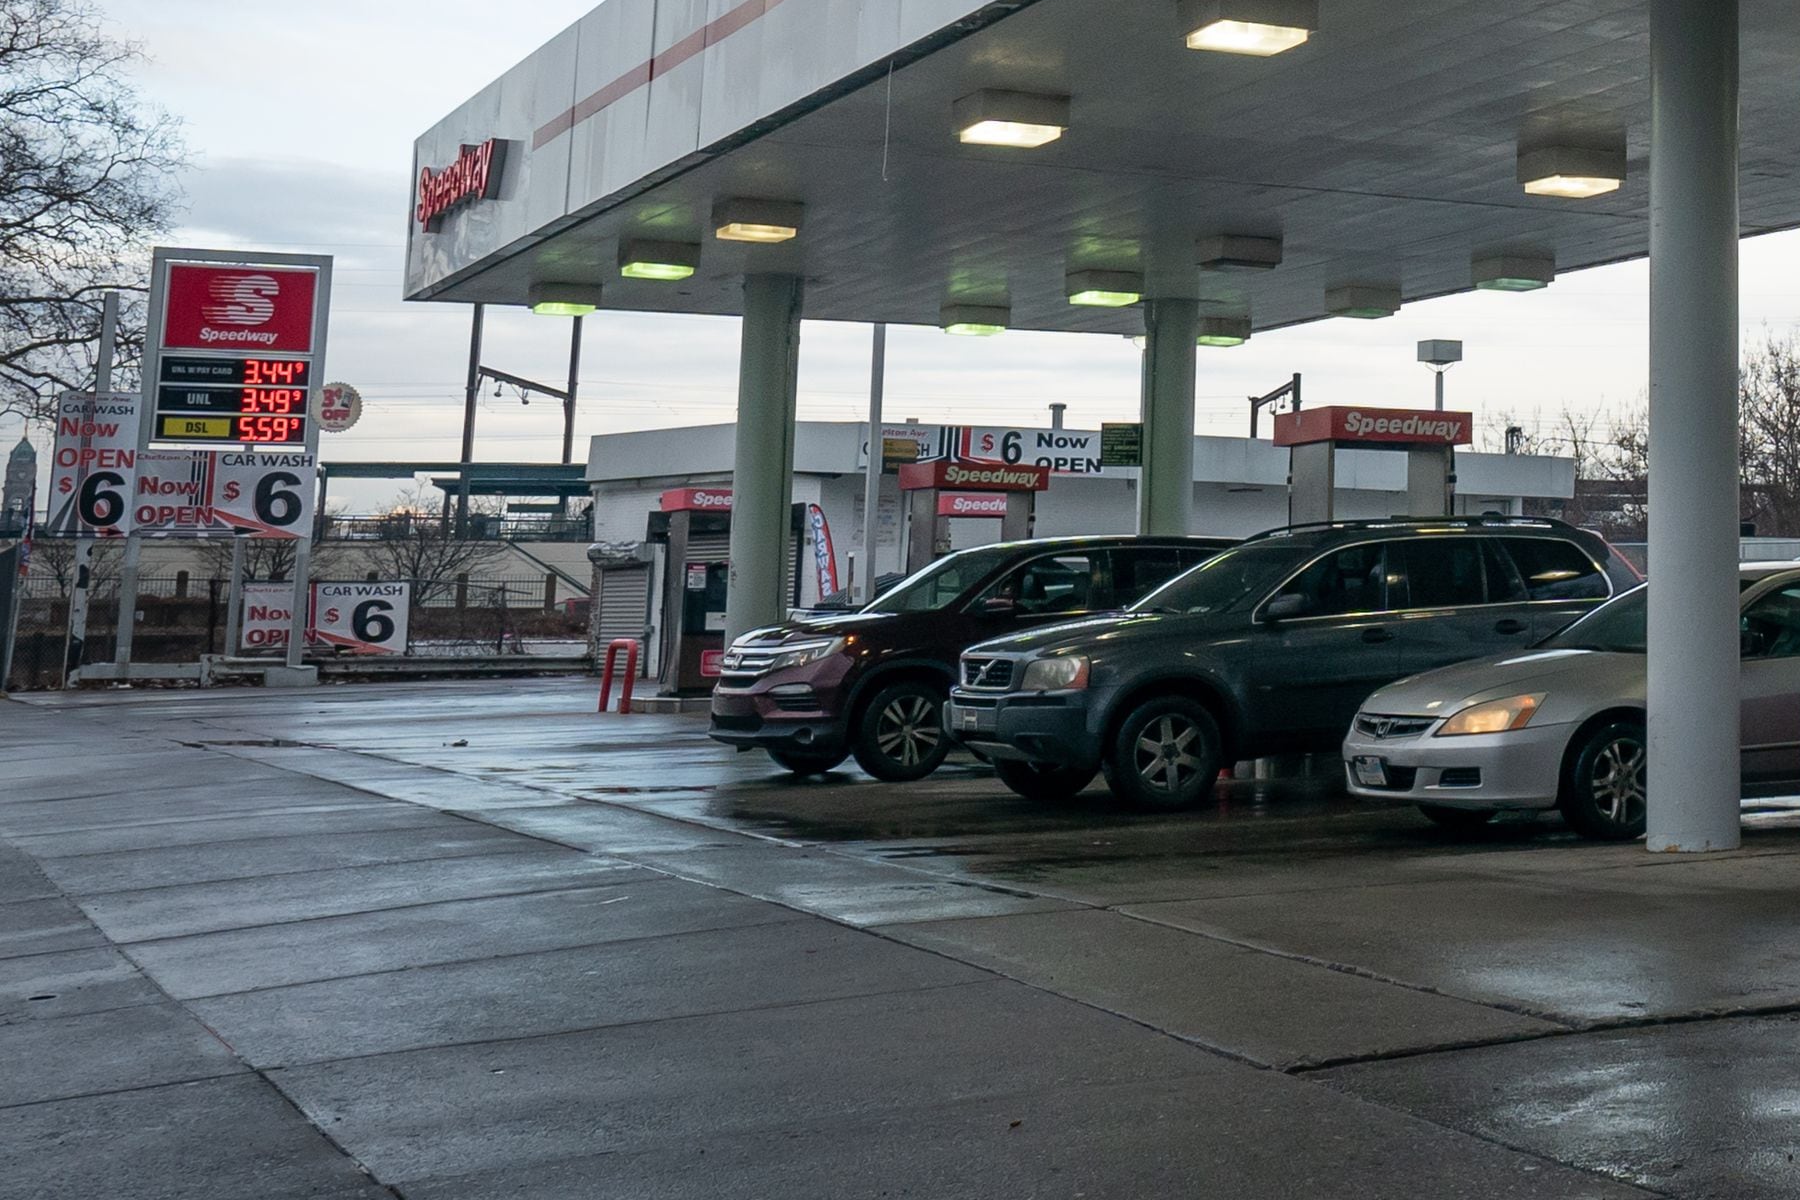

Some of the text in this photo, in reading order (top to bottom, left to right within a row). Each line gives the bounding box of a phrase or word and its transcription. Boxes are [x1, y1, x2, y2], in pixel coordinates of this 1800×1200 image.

[417, 138, 496, 233] Speedway
[200, 328, 278, 344] Speedway
[62, 404, 134, 415] CAR WASH
[187, 393, 211, 405] UNL
[321, 409, 350, 421] OFF
[185, 421, 209, 434] DSL
[1344, 412, 1462, 441] Speedway
[57, 447, 135, 469] OPEN
[1002, 430, 1023, 465] 6
[222, 453, 313, 467] CAR WASH
[1035, 456, 1102, 473] OPEN
[944, 466, 1040, 488] Speedway
[78, 471, 126, 527] 6
[254, 471, 303, 527] 6
[135, 505, 215, 526] OPEN
[322, 585, 403, 596] CAR WASH
[352, 599, 395, 643] 6
